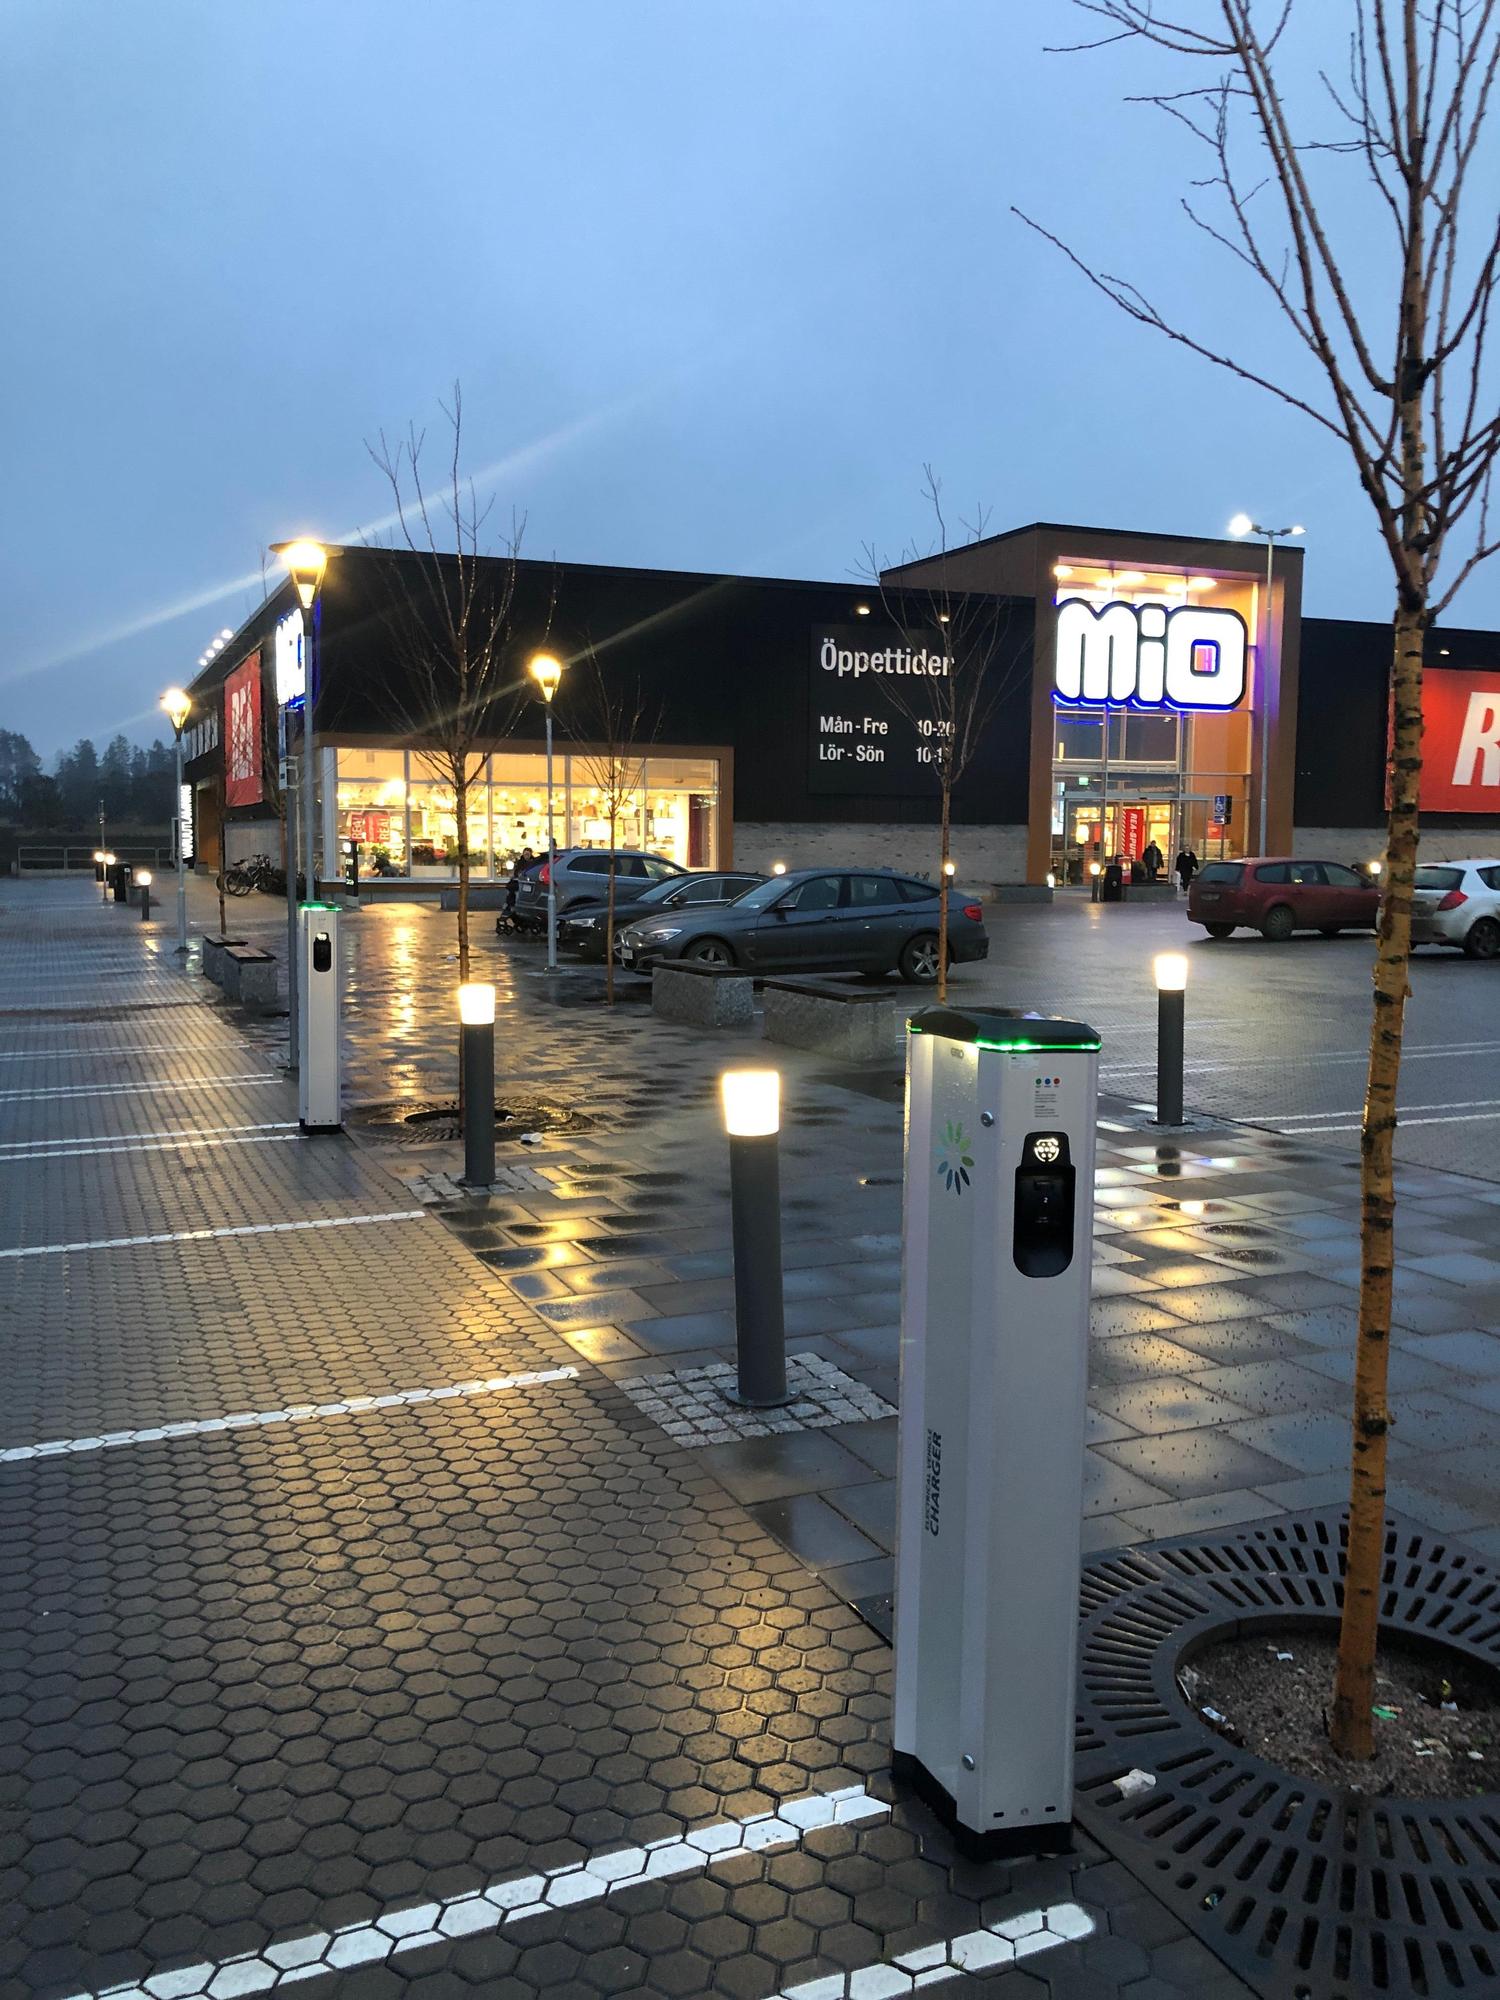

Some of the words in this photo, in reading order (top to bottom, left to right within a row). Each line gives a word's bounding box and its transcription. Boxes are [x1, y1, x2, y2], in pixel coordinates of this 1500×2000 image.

[820, 638, 954, 678] Öppettider
[915, 746, 951, 764] 10-1
[929, 1431, 942, 1537] CHARGER
